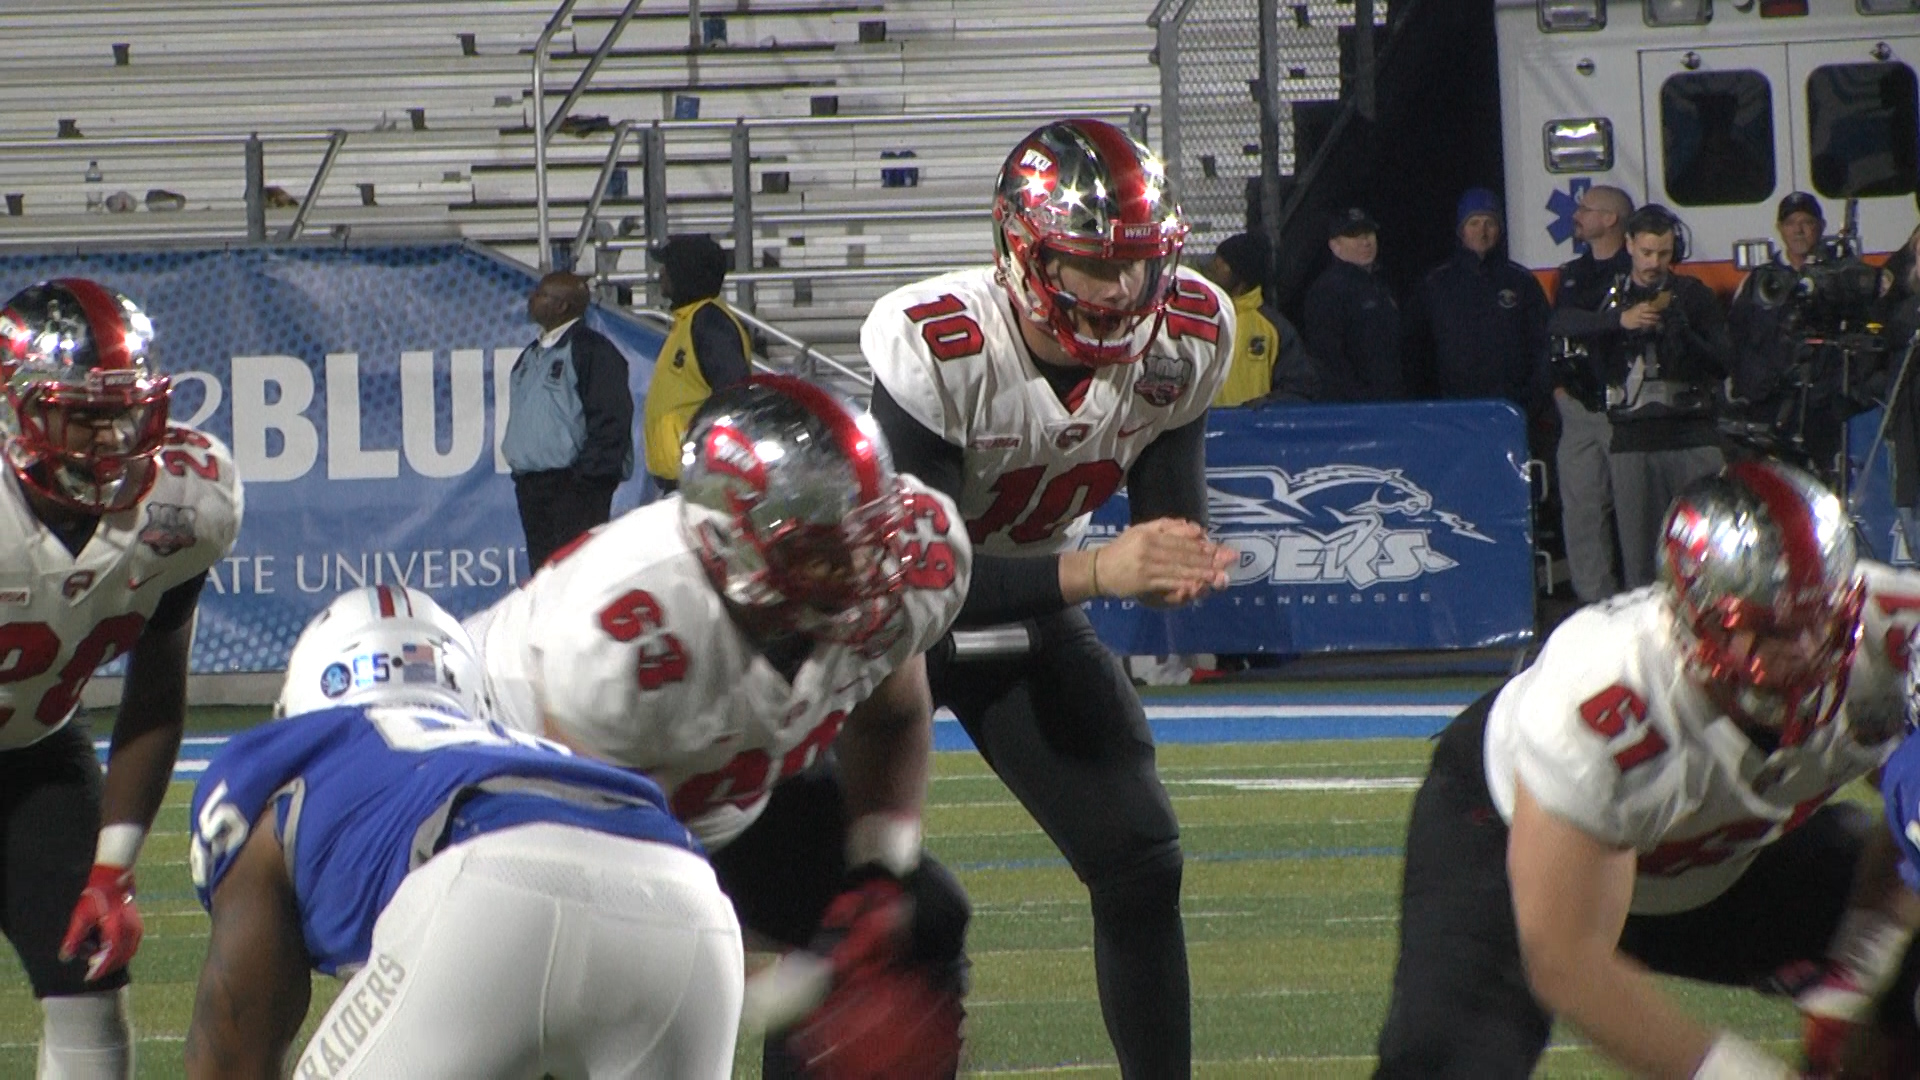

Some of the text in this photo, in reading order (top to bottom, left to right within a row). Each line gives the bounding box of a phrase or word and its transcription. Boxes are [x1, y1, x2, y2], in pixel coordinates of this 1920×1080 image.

[1124, 227, 1151, 239] WKU
[903, 294, 984, 361] 10
[965, 457, 1124, 544] 10
[206, 546, 528, 595] ATE UNIVERSI
[1233, 592, 1432, 606] TENNESSEE
[1579, 683, 1670, 772] 61
